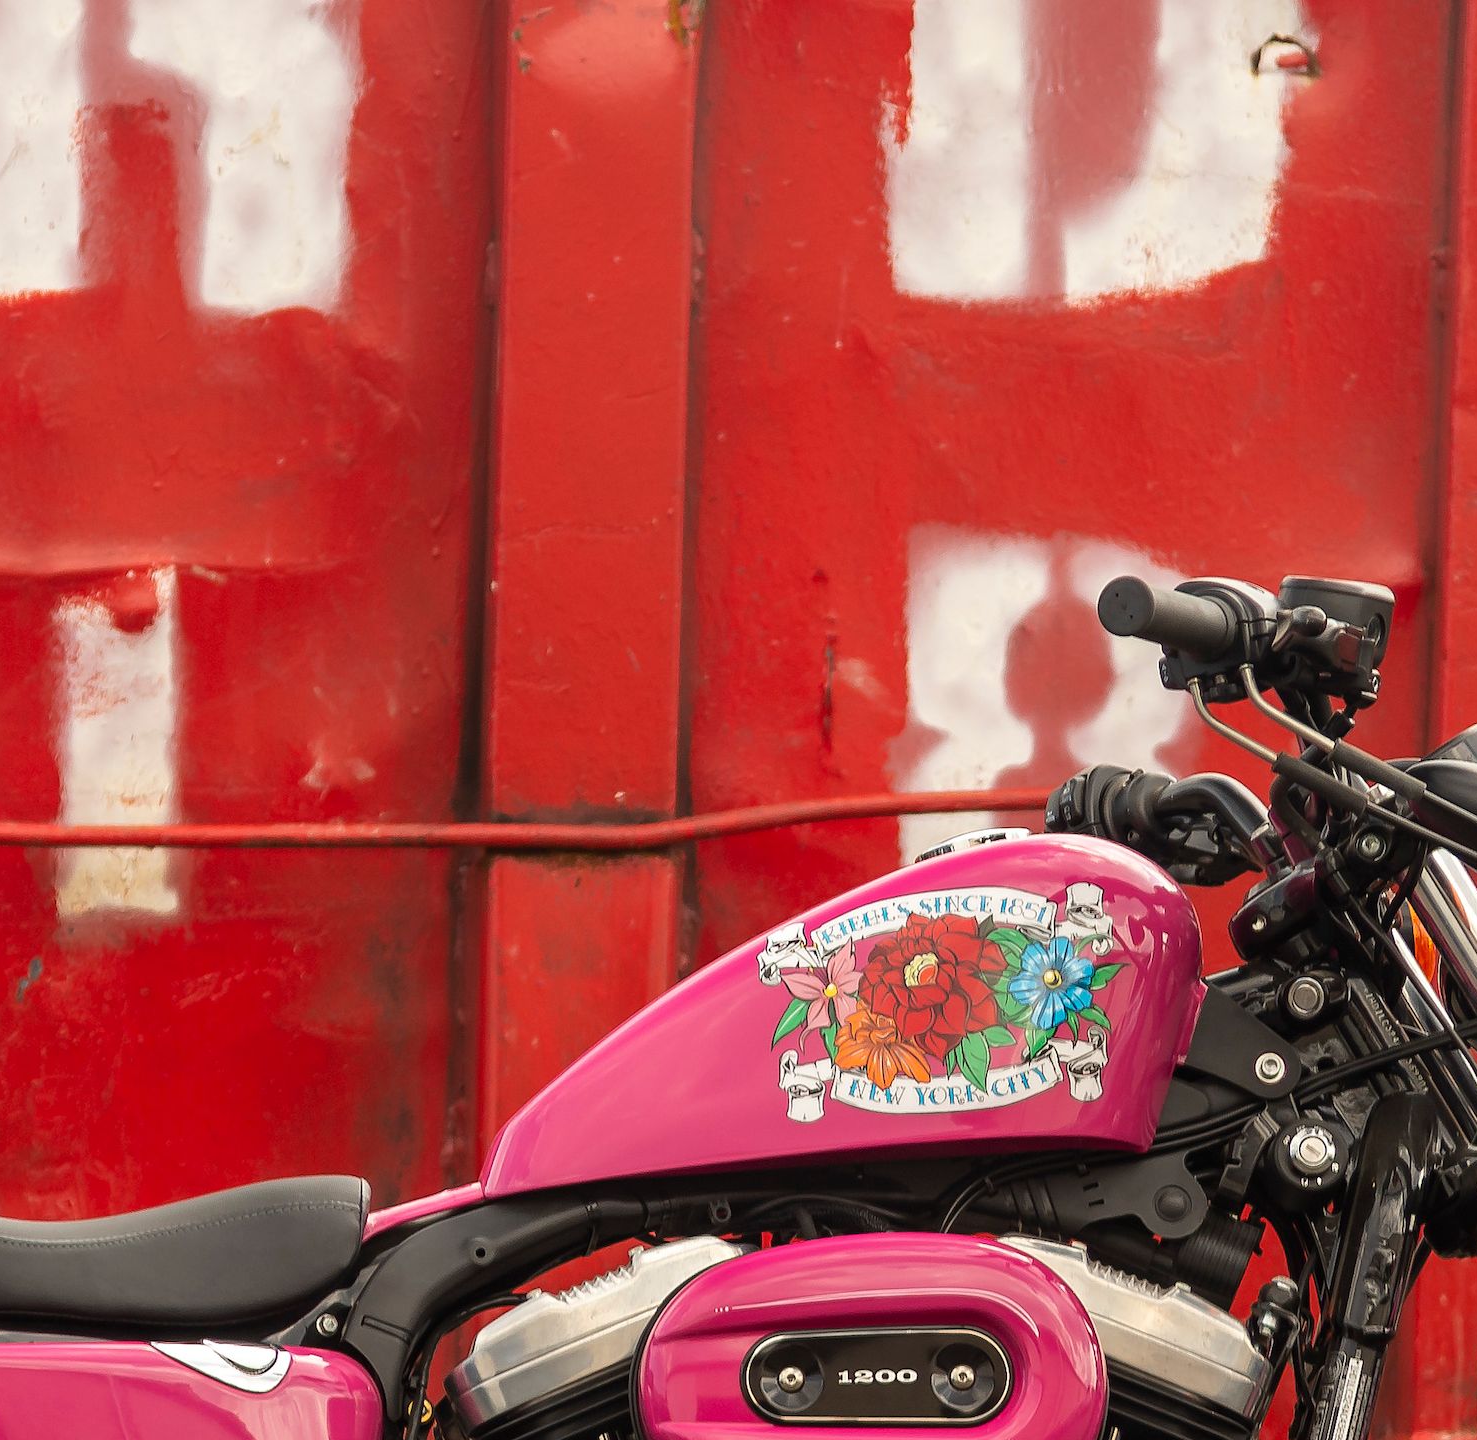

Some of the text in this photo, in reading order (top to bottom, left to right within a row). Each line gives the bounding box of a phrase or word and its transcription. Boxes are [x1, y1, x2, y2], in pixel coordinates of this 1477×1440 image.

[821, 894, 1047, 945] KIEHL'S SINCE 1851
[849, 1063, 1048, 1106] NEW YORK CITY
[838, 1368, 919, 1385] 1200
